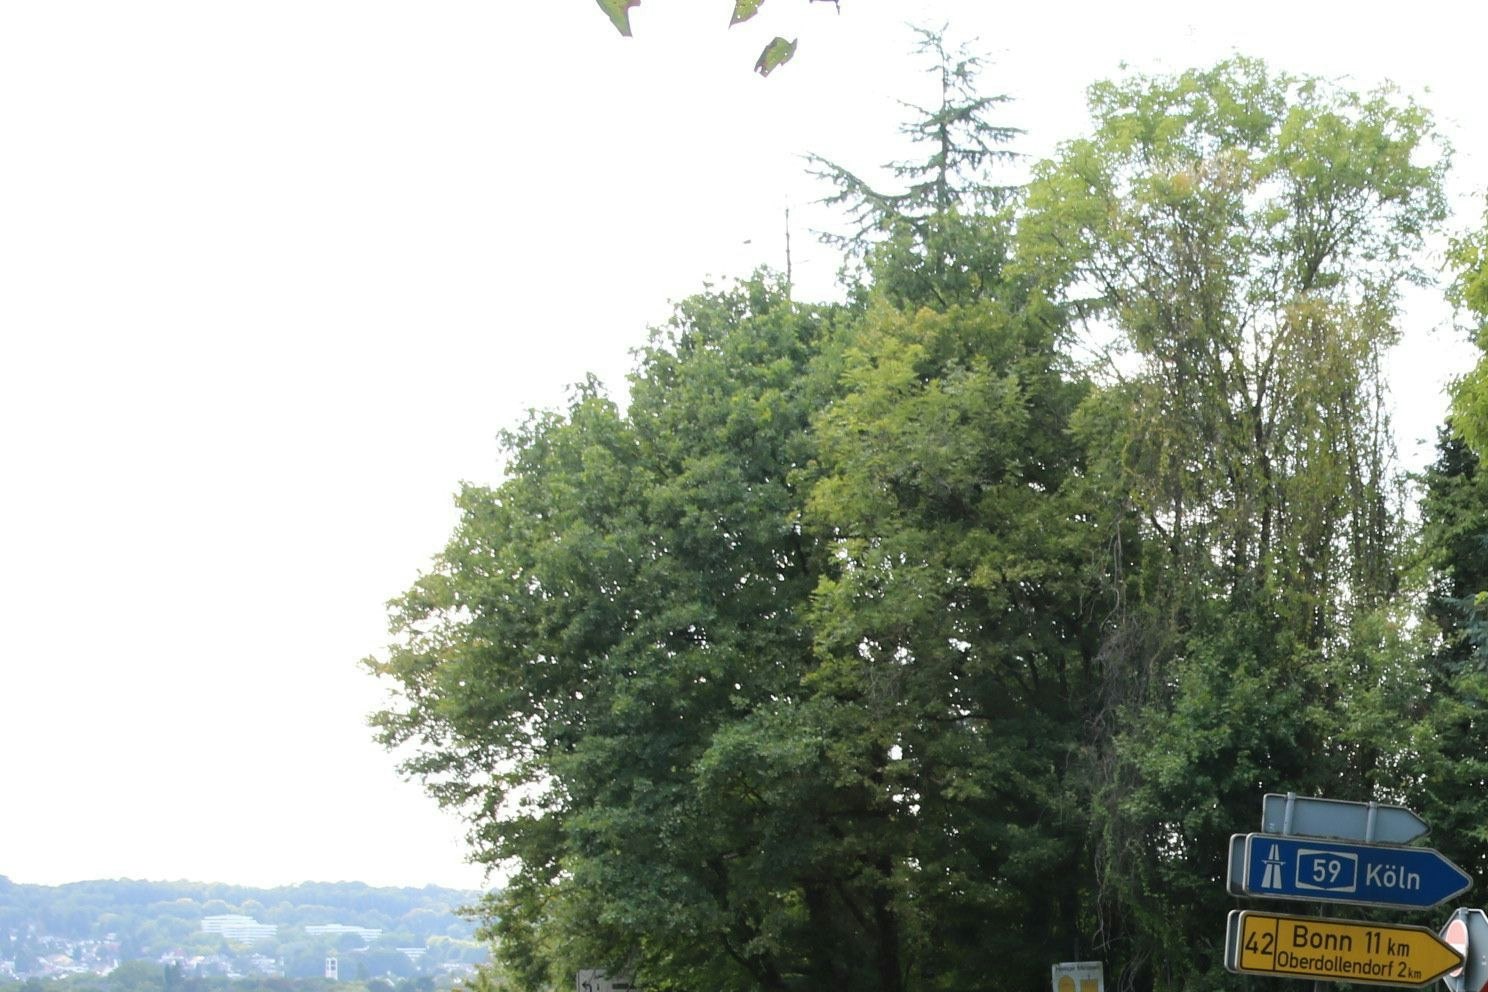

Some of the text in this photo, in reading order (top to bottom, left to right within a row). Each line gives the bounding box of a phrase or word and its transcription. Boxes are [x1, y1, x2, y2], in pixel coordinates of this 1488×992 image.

[1312, 858, 1342, 884] 59
[1365, 862, 1421, 891] Köln
[1244, 930, 1275, 956] 42
[1292, 924, 1411, 958] Bonn 11 km
[1276, 950, 1423, 980] Oberdollendorf 2 km
